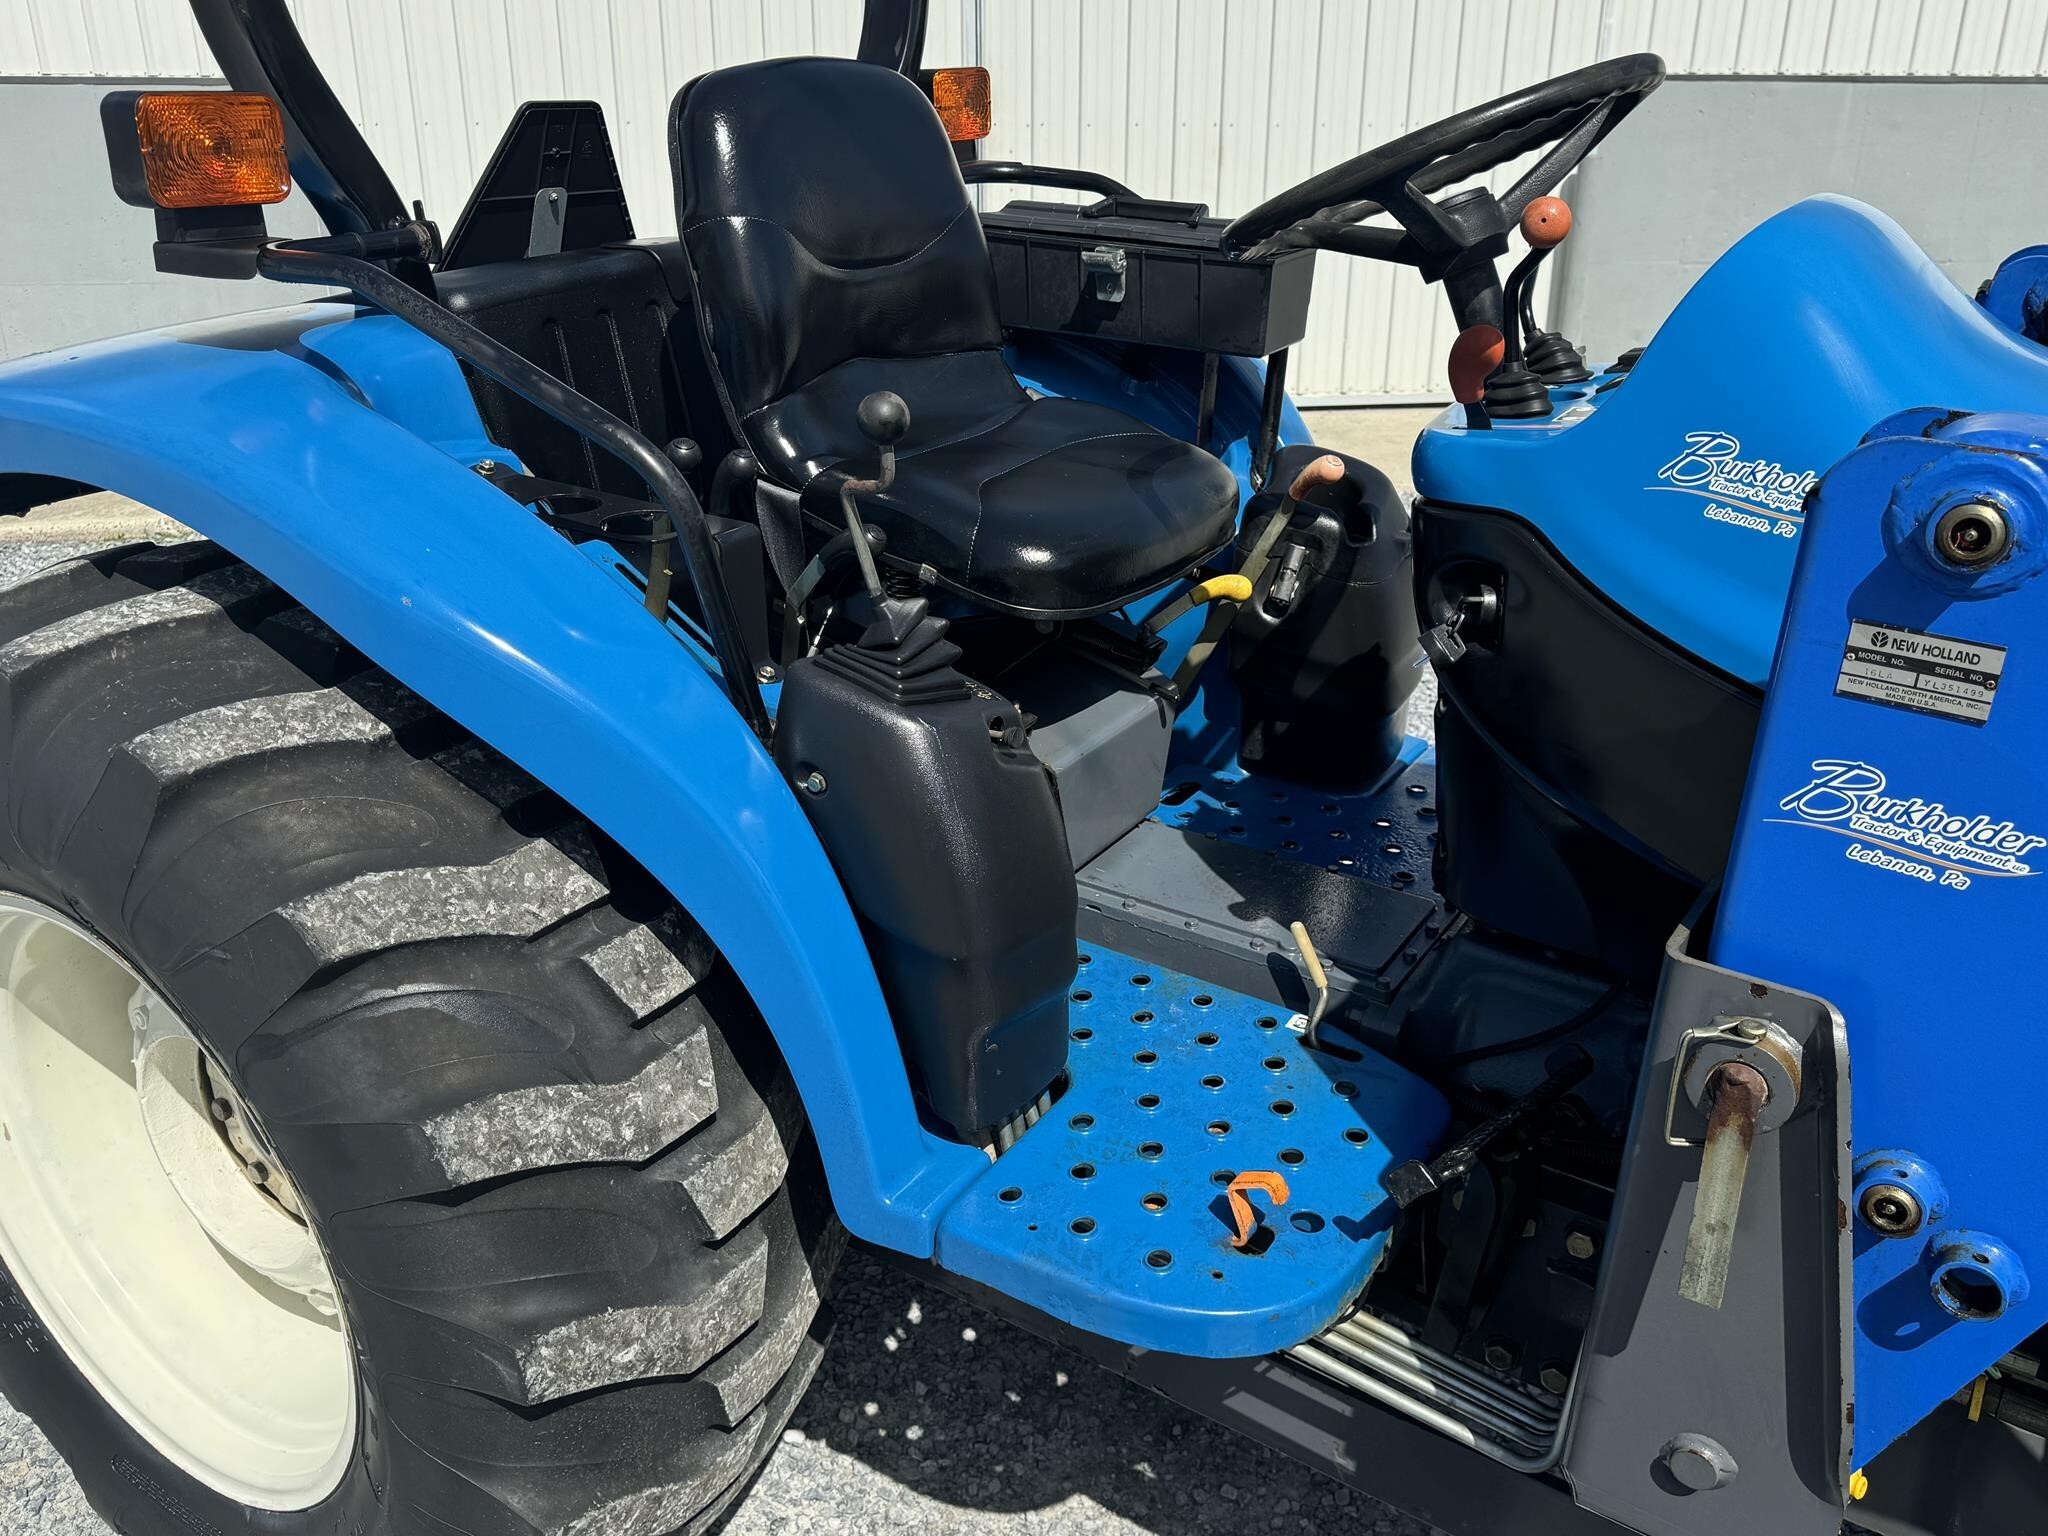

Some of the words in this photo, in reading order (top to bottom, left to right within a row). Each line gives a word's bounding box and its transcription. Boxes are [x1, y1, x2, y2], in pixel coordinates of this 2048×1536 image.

[1710, 478, 1749, 497] Tractor
[1750, 489, 1762, 501] &
[1705, 504, 1772, 531] Lebanon,
[1774, 521, 1796, 537] Pa
[1858, 651, 1887, 664] MODEL
[1890, 658, 1906, 667] NO.
[1934, 667, 1965, 679] SERIAL
[1891, 638, 1919, 654] NEW
[1921, 642, 1981, 666] HOLLAND
[1847, 678, 1864, 686] NEW
[1865, 681, 1900, 694] HOLLAND
[1901, 688, 1927, 700] NORTH
[1928, 693, 1963, 707] AMERICA,
[1885, 692, 1906, 702] MADE
[1780, 759, 2047, 855] Burkholder
[1851, 815, 1905, 839] Tractor
[1906, 832, 1920, 844] &
[1924, 836, 2011, 868] Equipment
[1847, 845, 1936, 881] Lebanon,
[1939, 870, 1970, 890] Pa
